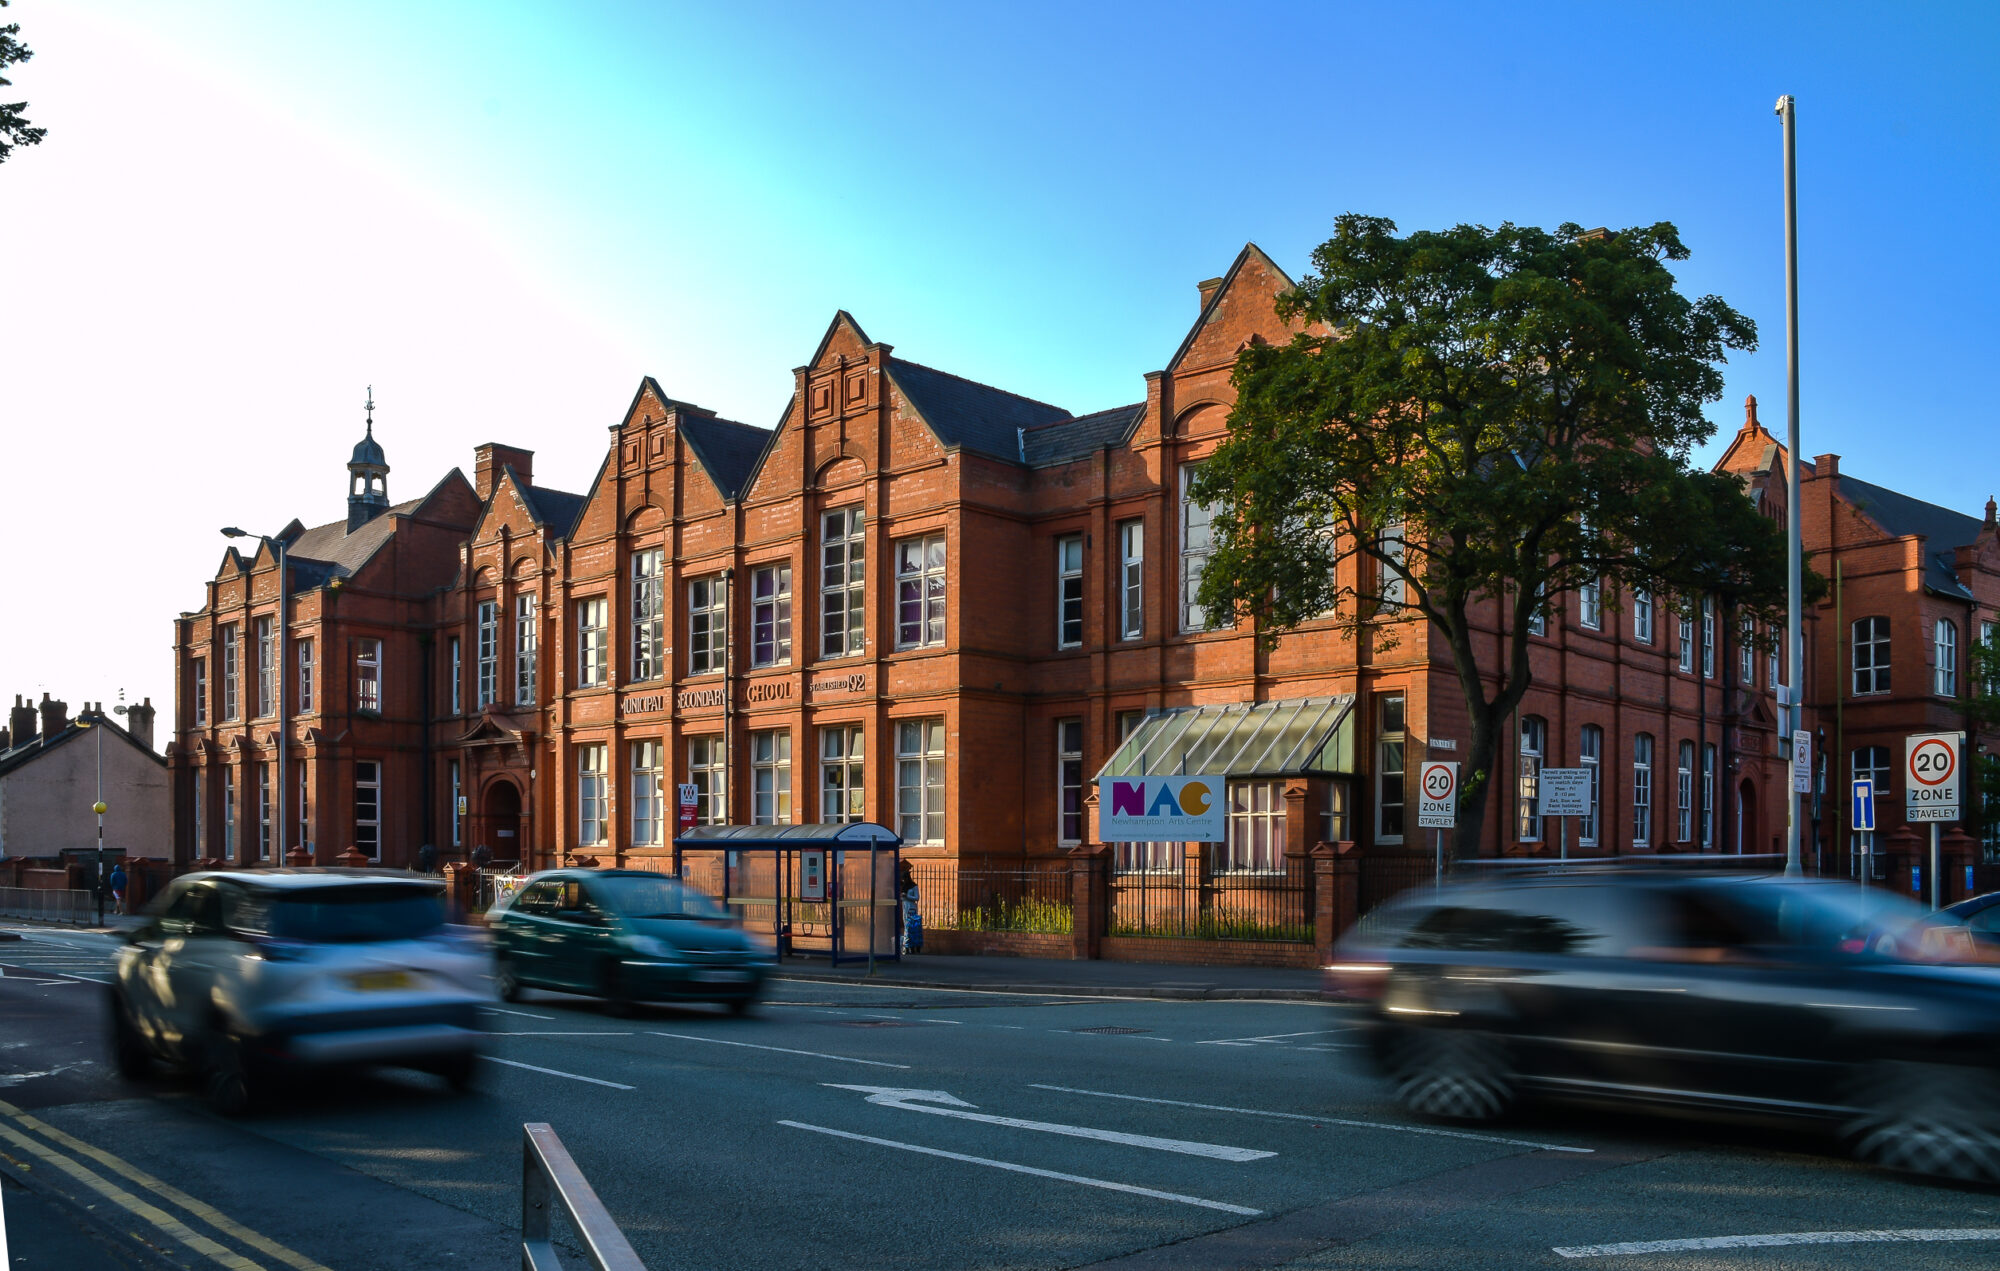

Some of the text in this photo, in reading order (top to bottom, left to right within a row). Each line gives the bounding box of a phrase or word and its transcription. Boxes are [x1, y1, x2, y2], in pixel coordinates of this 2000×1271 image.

[621, 695, 664, 714] MUNICIPAL
[678, 688, 725, 709] SECONDARY
[743, 682, 793, 702] CHOOL
[808, 680, 847, 692] STABLISHED
[1917, 752, 1948, 771] 20
[1428, 775, 1449, 789] 20
[1112, 781, 1212, 816] NAC
[1912, 788, 1953, 801] ZONE
[1423, 802, 1451, 811] ZONE
[1909, 808, 1957, 819] STAVELEY
[1112, 817, 1213, 826] Newhampton Arts Centre
